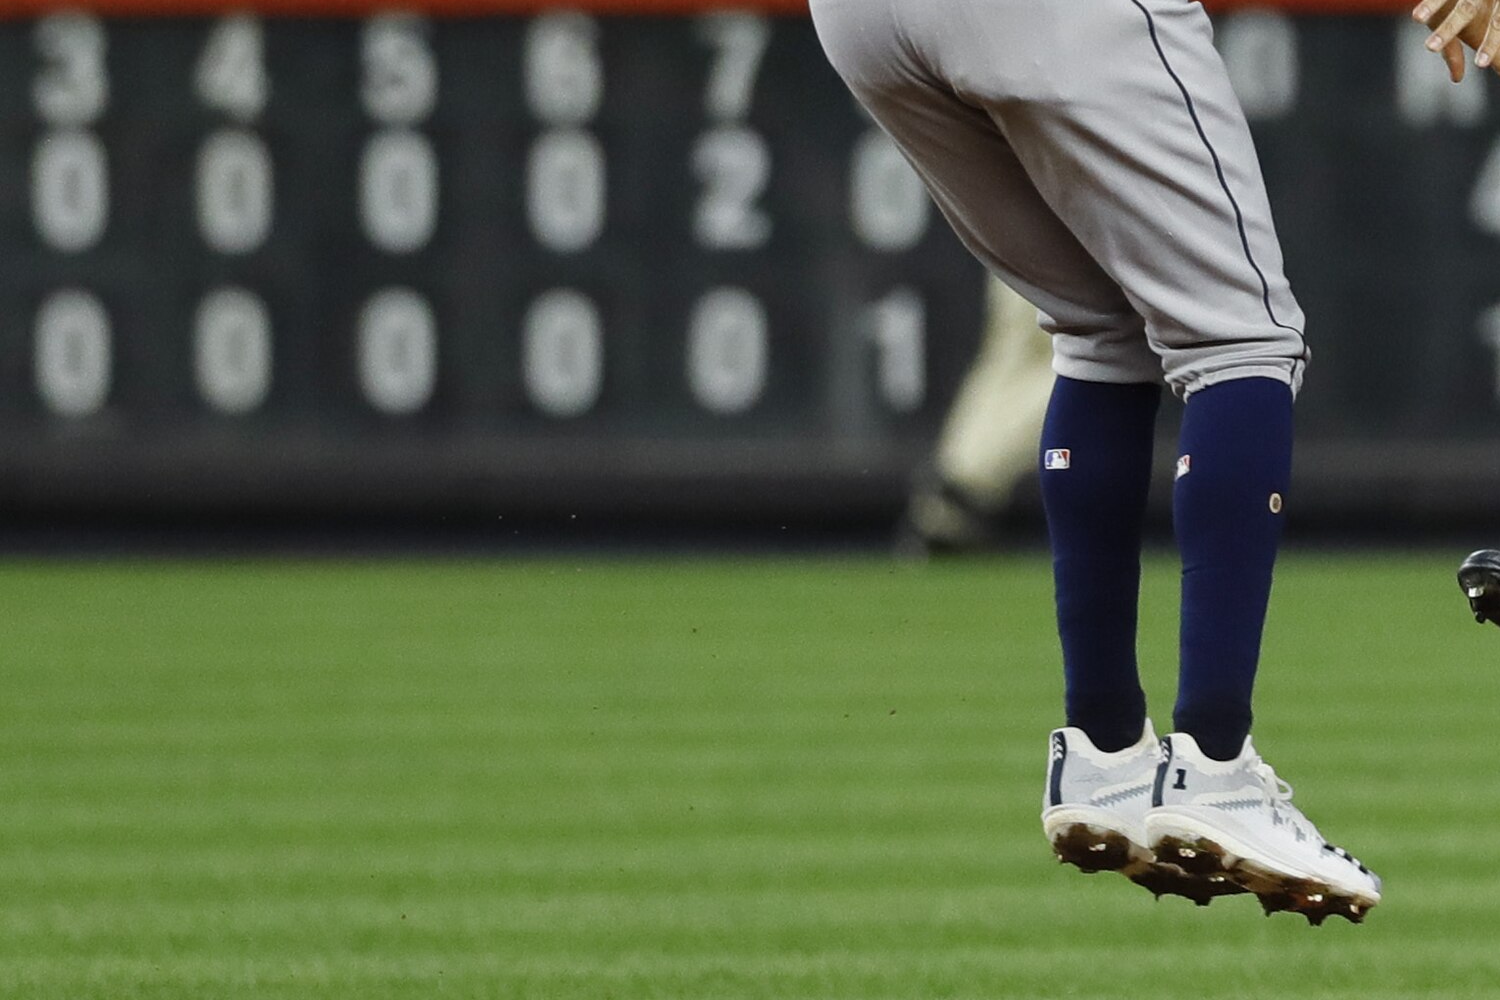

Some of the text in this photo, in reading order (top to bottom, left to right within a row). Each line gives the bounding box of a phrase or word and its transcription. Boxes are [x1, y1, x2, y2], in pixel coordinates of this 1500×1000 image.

[32, 12, 109, 122] 3
[195, 12, 269, 122] 4
[361, 12, 437, 122] 5
[525, 12, 602, 122] 6
[697, 12, 768, 122] 7
[31, 128, 109, 253] 0
[196, 128, 273, 253] 0
[360, 128, 438, 253] 0
[526, 128, 606, 253] 0
[692, 127, 772, 251] 2
[34, 289, 111, 419] 0
[194, 288, 272, 415] 0
[358, 288, 437, 415] 0
[523, 288, 603, 417] 0
[687, 287, 768, 415] 0
[872, 290, 926, 412] 1
[1172, 768, 1187, 790] 1
